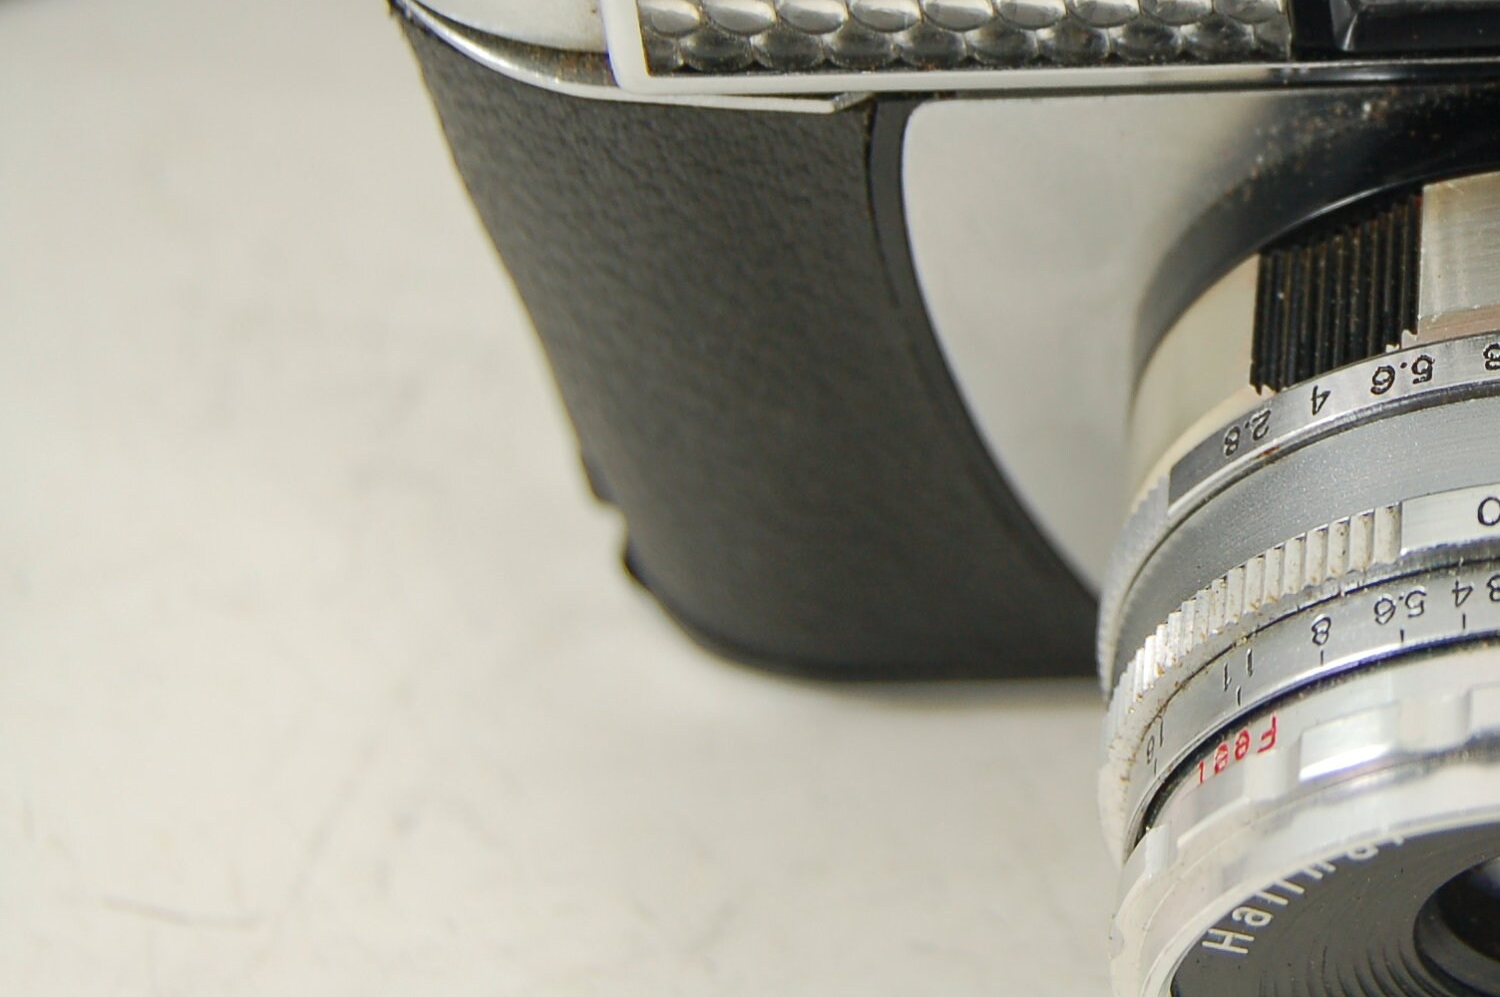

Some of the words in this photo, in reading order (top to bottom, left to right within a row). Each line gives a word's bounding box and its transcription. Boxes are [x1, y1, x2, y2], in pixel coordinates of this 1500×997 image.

[1371, 354, 1436, 396] 5.6
[1310, 385, 1332, 416] 4
[1223, 408, 1272, 457] 2.8
[1373, 587, 1428, 626] 5.6
[1451, 580, 1474, 608] 4
[1311, 614, 1333, 647] 8
